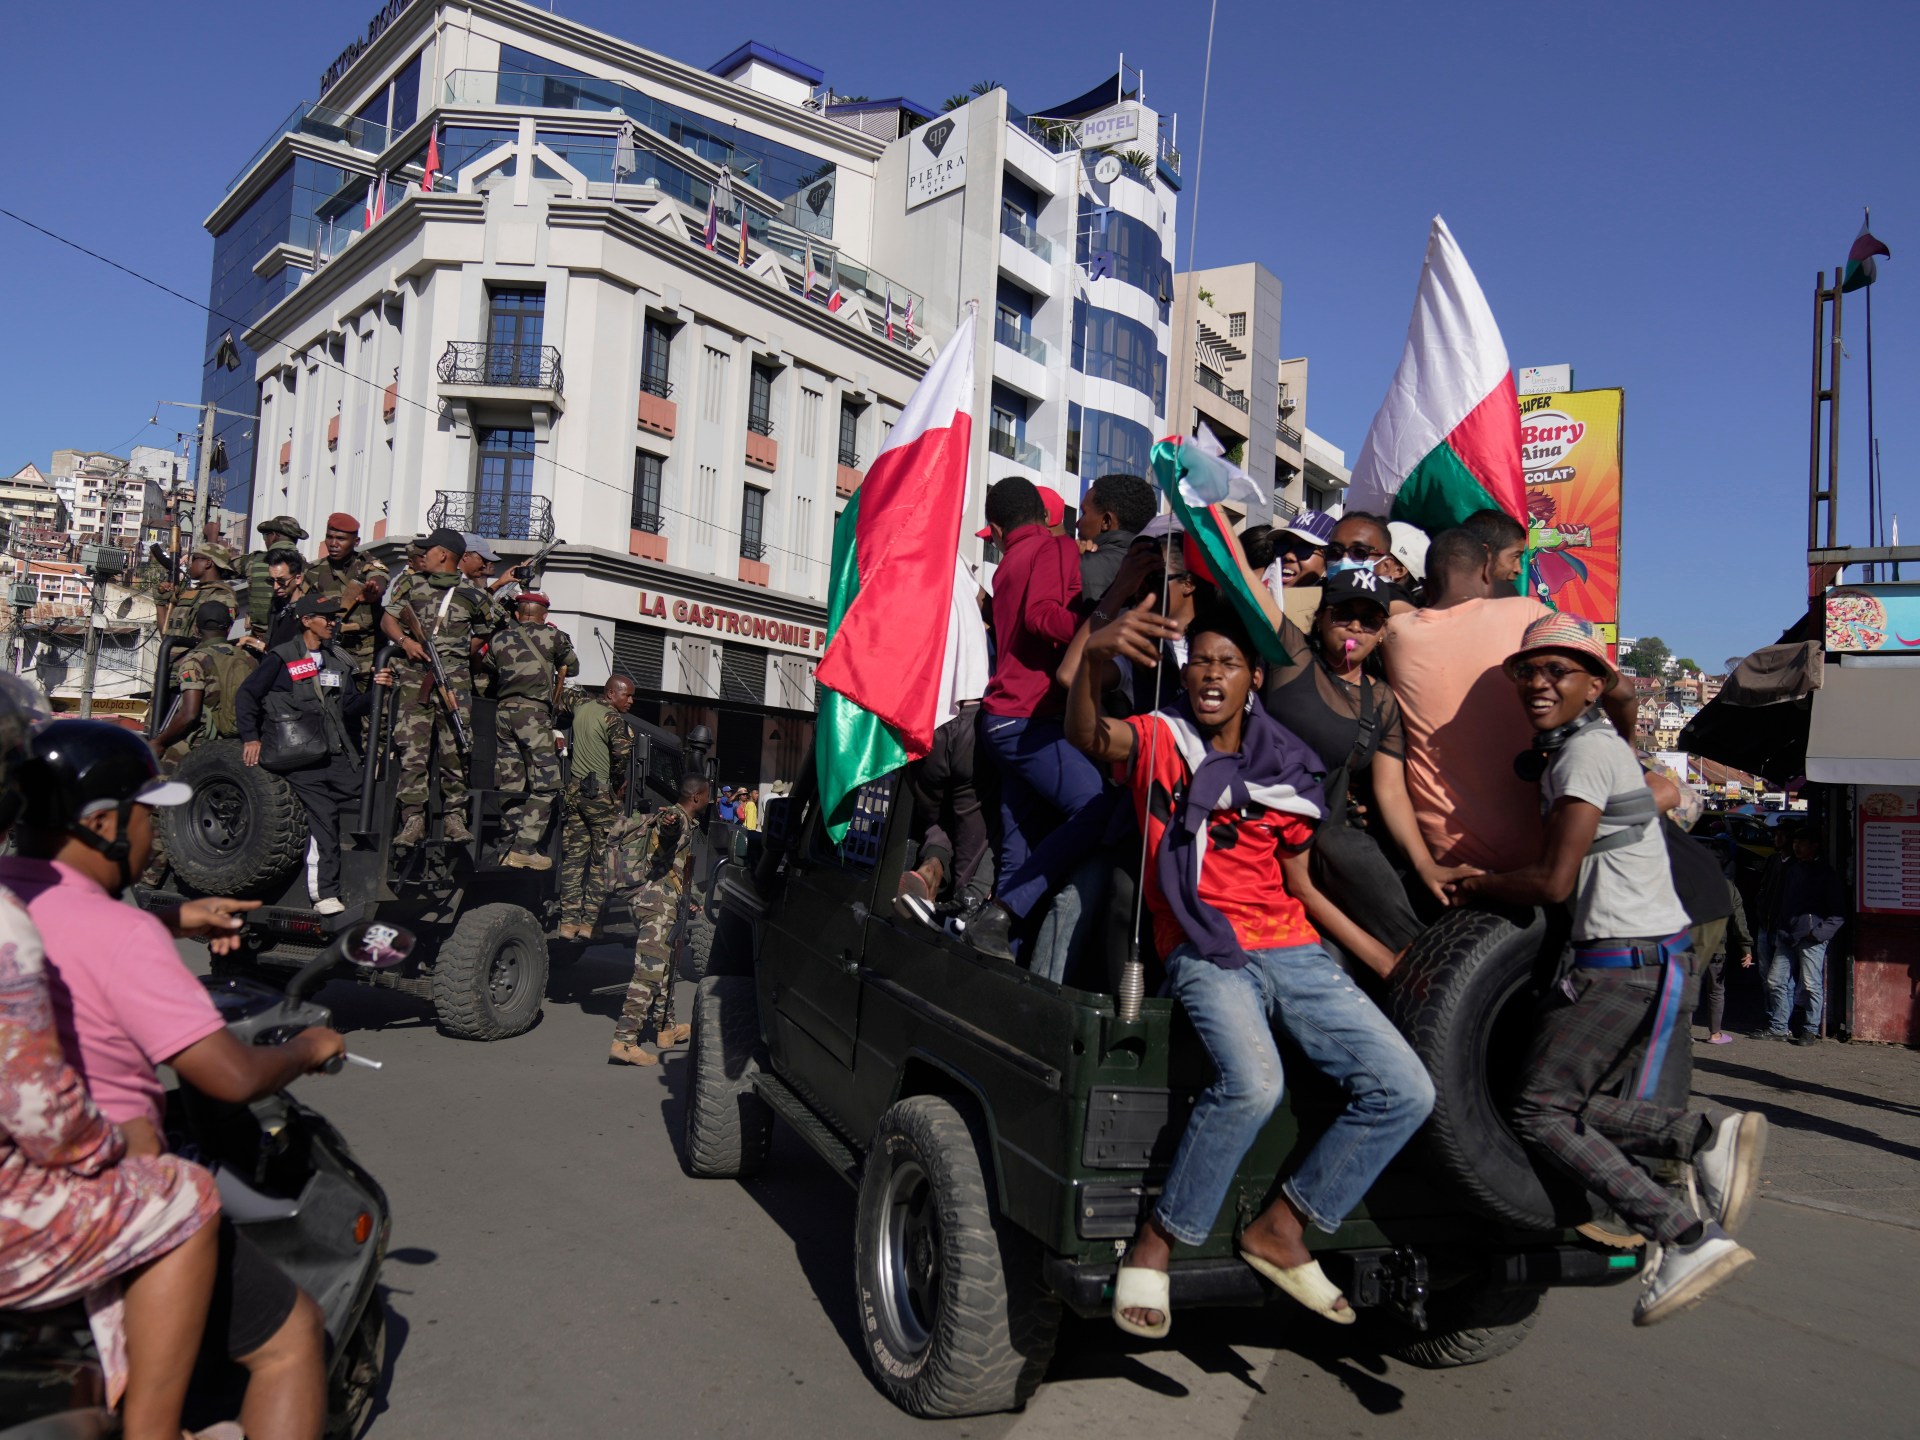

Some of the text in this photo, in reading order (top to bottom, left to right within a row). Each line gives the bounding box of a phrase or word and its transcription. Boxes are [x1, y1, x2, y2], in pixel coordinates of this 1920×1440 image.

[1085, 115, 1134, 136] HOTEL
[910, 155, 965, 188] PIETRA
[920, 173, 951, 191] HOTEL
[1521, 423, 1584, 445] Bary
[1522, 446, 1562, 461] Aina
[639, 592, 667, 619] LA
[673, 600, 811, 648] GASTRONOMIE
